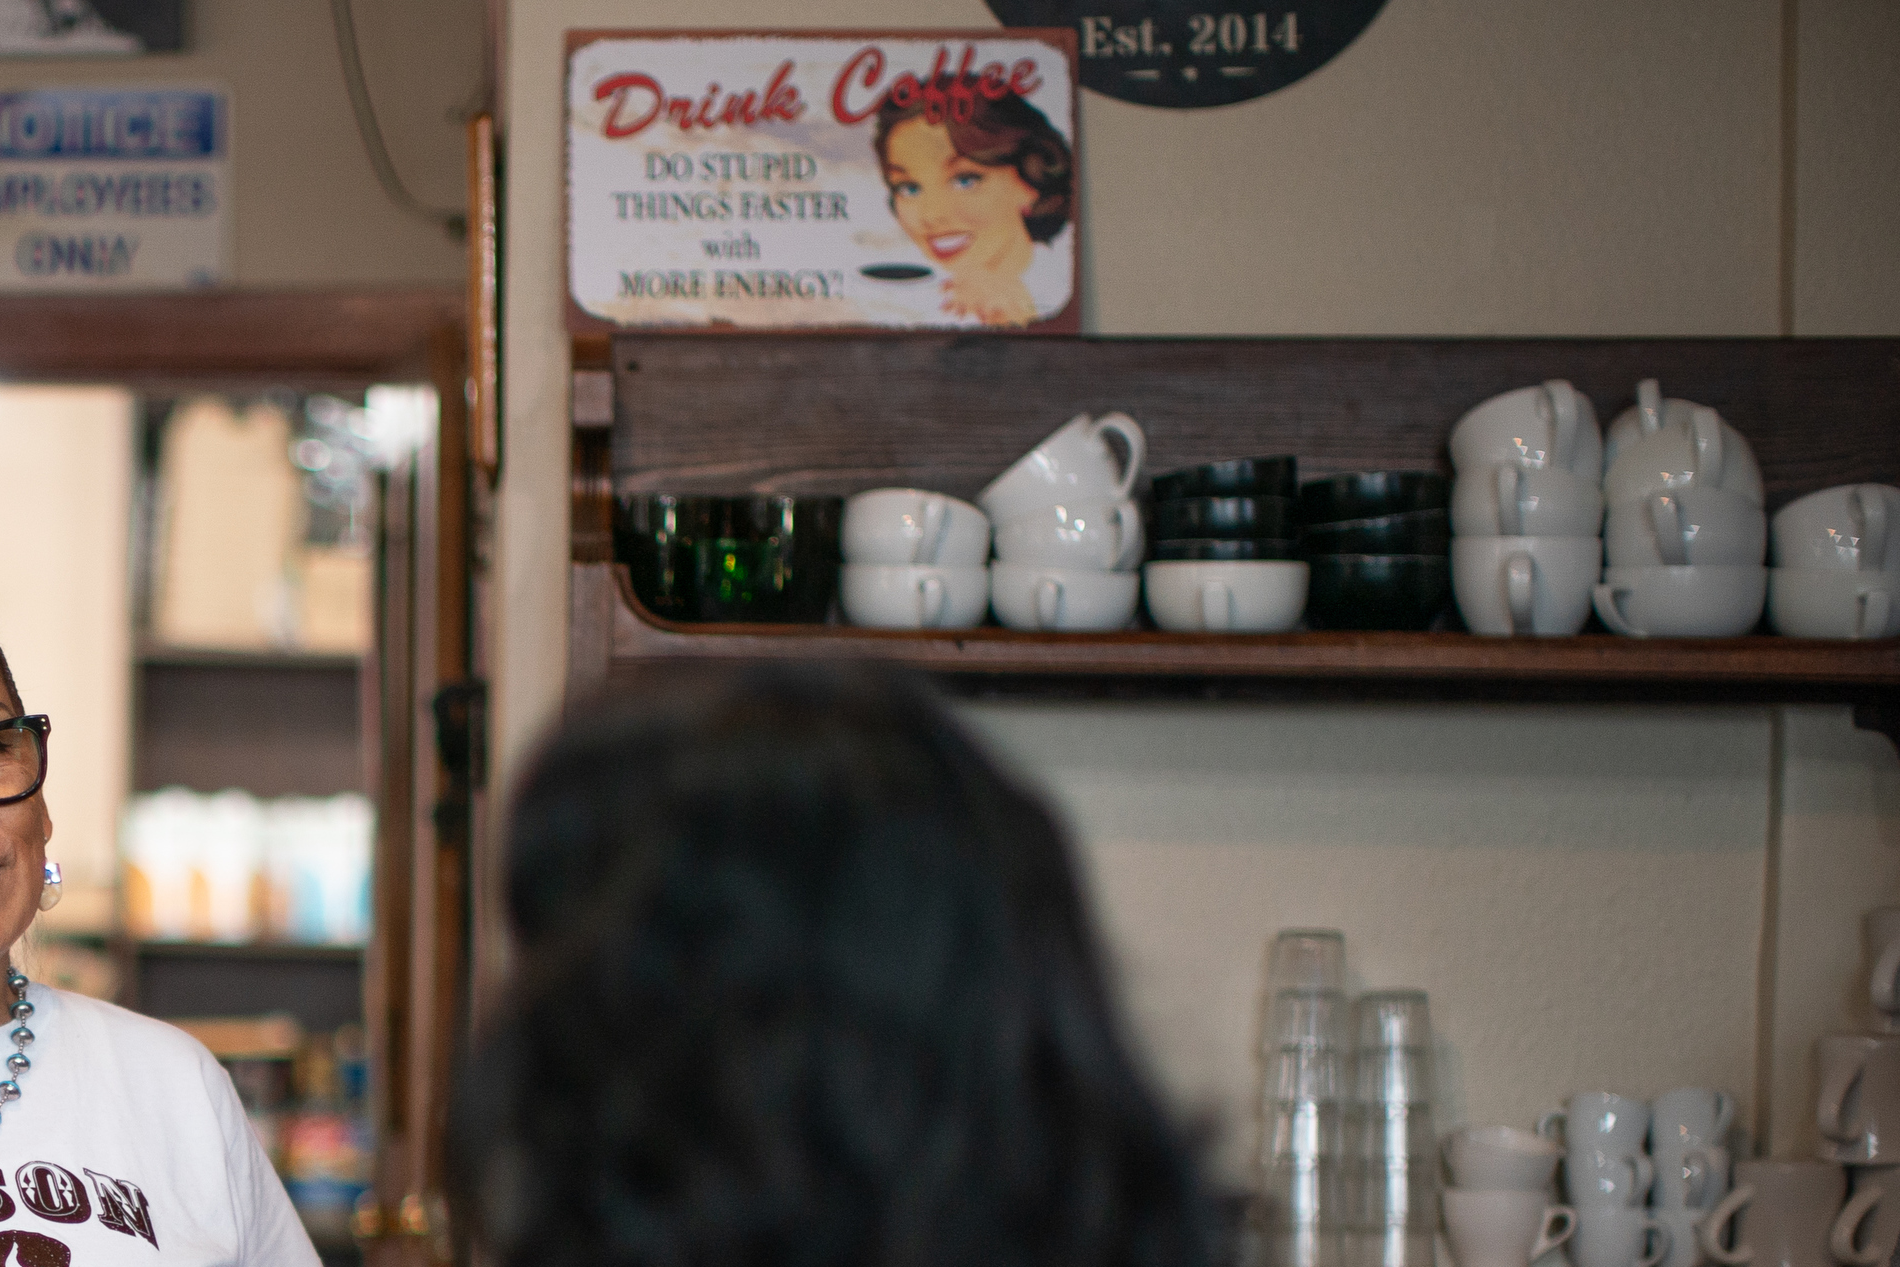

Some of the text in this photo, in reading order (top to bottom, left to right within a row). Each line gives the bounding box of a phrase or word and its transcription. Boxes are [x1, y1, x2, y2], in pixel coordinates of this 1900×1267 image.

[1080, 11, 1303, 58] Est. 2014
[594, 43, 1044, 139] Drink Coffee
[645, 152, 818, 181] DO STUPID
[612, 190, 851, 221] THINGS FASTER
[13, 234, 140, 276] ONLY
[701, 230, 762, 259] with
[618, 269, 844, 301] MORE ENERGY!
